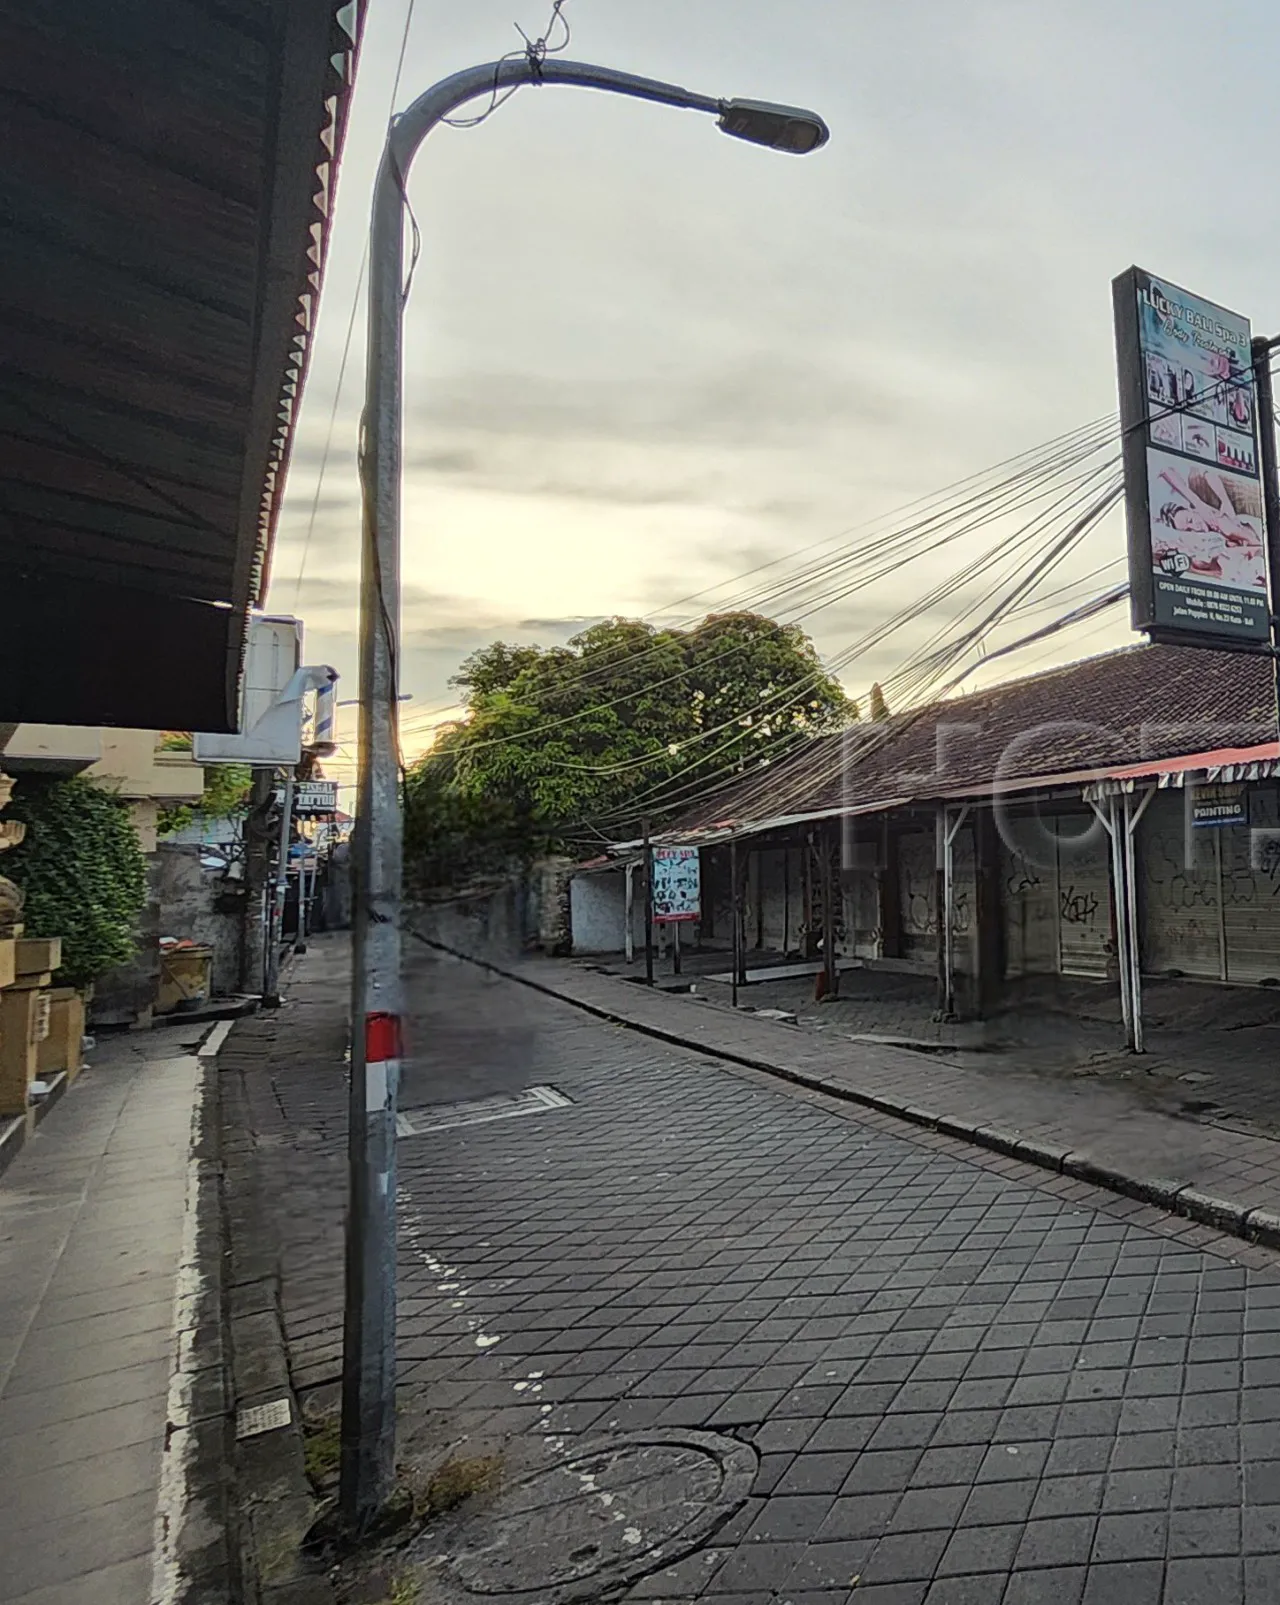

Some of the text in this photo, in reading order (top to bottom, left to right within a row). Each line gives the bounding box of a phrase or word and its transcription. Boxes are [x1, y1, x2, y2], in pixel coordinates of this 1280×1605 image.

[1142, 288, 1248, 348] LUCKY BALI Spa 3
[1163, 318, 1189, 342] Body
[1159, 581, 1174, 591] OPEN
[1175, 584, 1190, 594] DAILY
[1194, 804, 1241, 818] PAINTING
